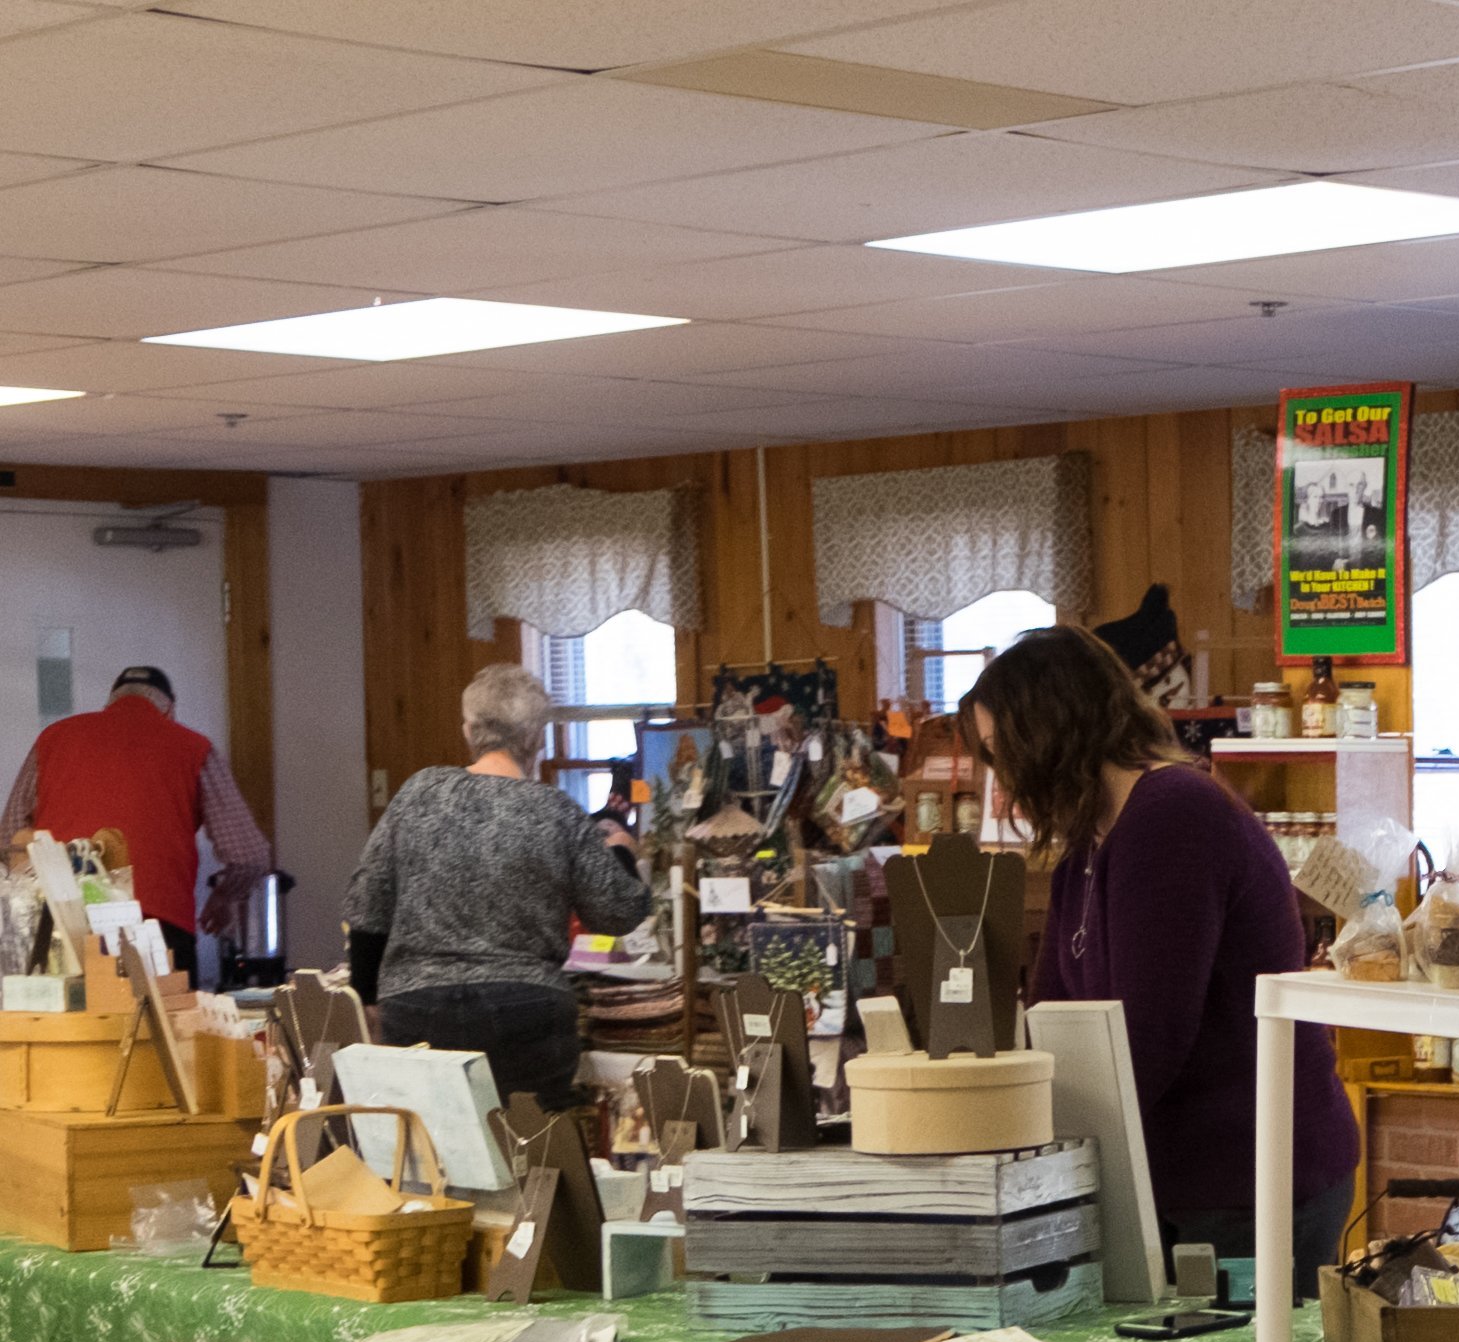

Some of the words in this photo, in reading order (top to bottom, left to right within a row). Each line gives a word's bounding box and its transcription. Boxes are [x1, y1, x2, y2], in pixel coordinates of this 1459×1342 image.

[1295, 409, 1318, 425] To
[1321, 407, 1353, 424] Get
[1356, 406, 1392, 422] Our
[1295, 420, 1389, 446] SALSA
[1319, 592, 1358, 610] BEST
